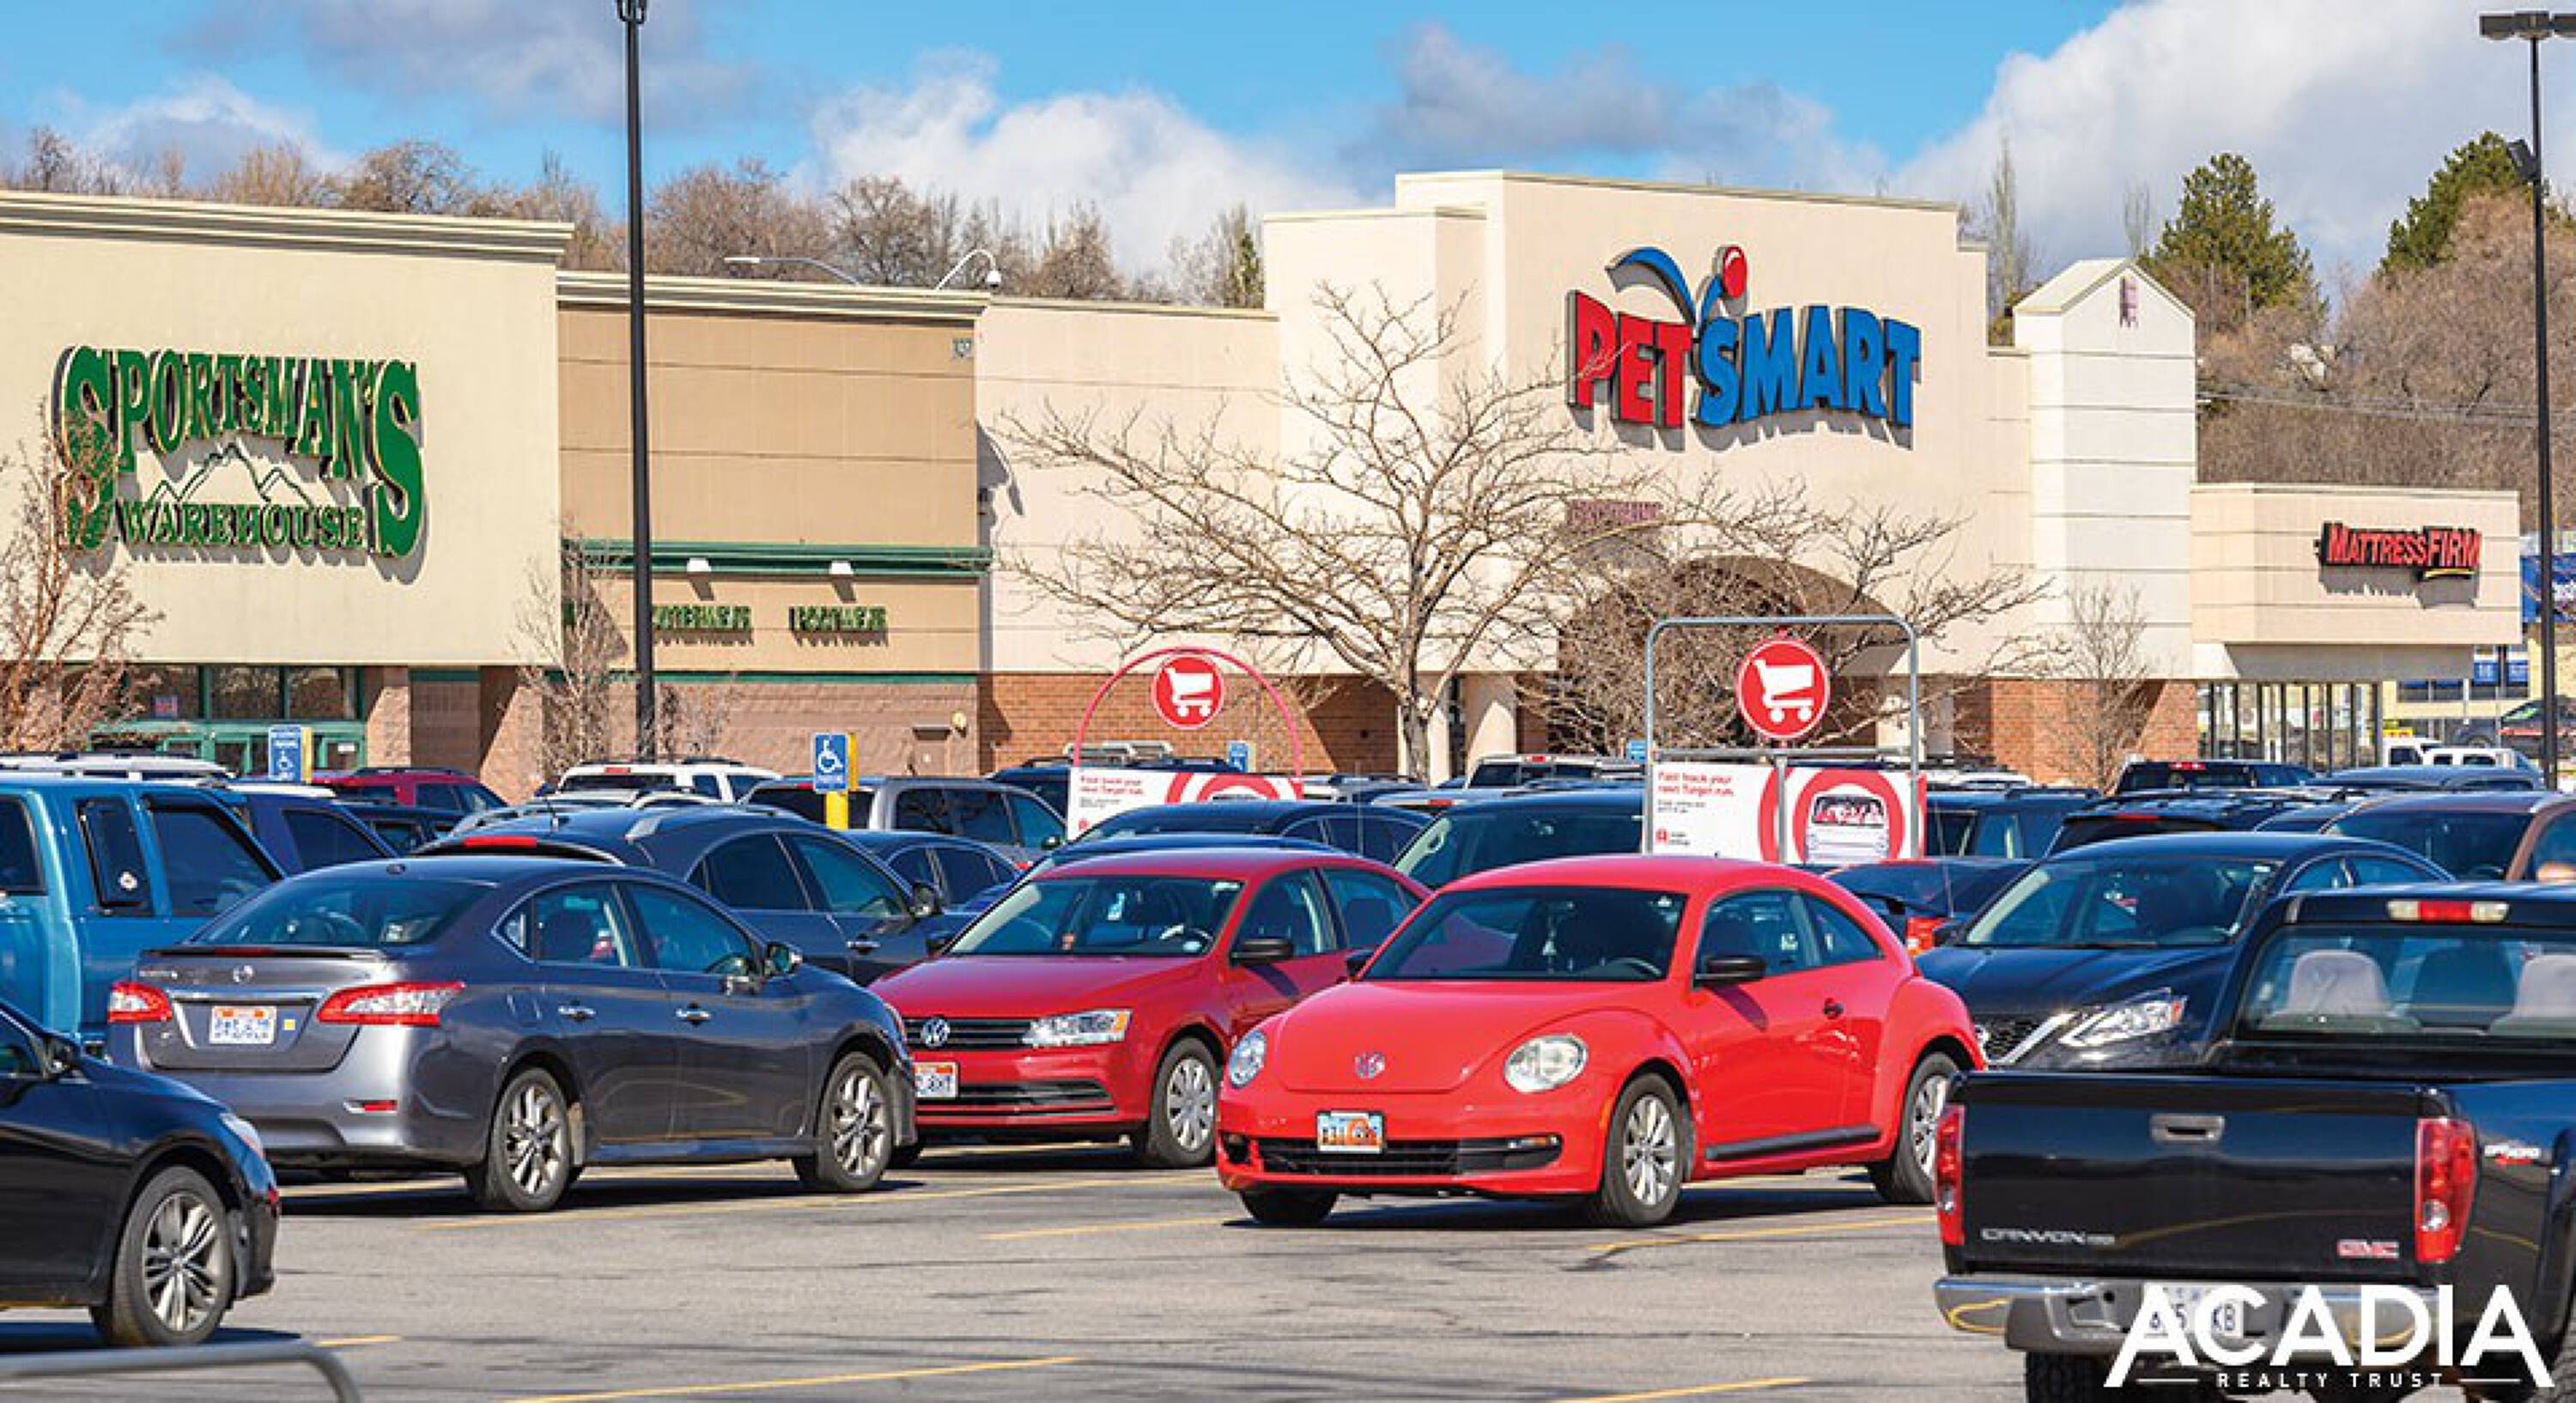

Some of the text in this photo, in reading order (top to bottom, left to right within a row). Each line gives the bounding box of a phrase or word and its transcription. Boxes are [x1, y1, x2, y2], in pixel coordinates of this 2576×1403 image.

[57, 345, 423, 558] SPORTSMAN'S
[118, 502, 366, 548] WAREHOUSE
[2337, 1238, 2400, 1259] GMC
